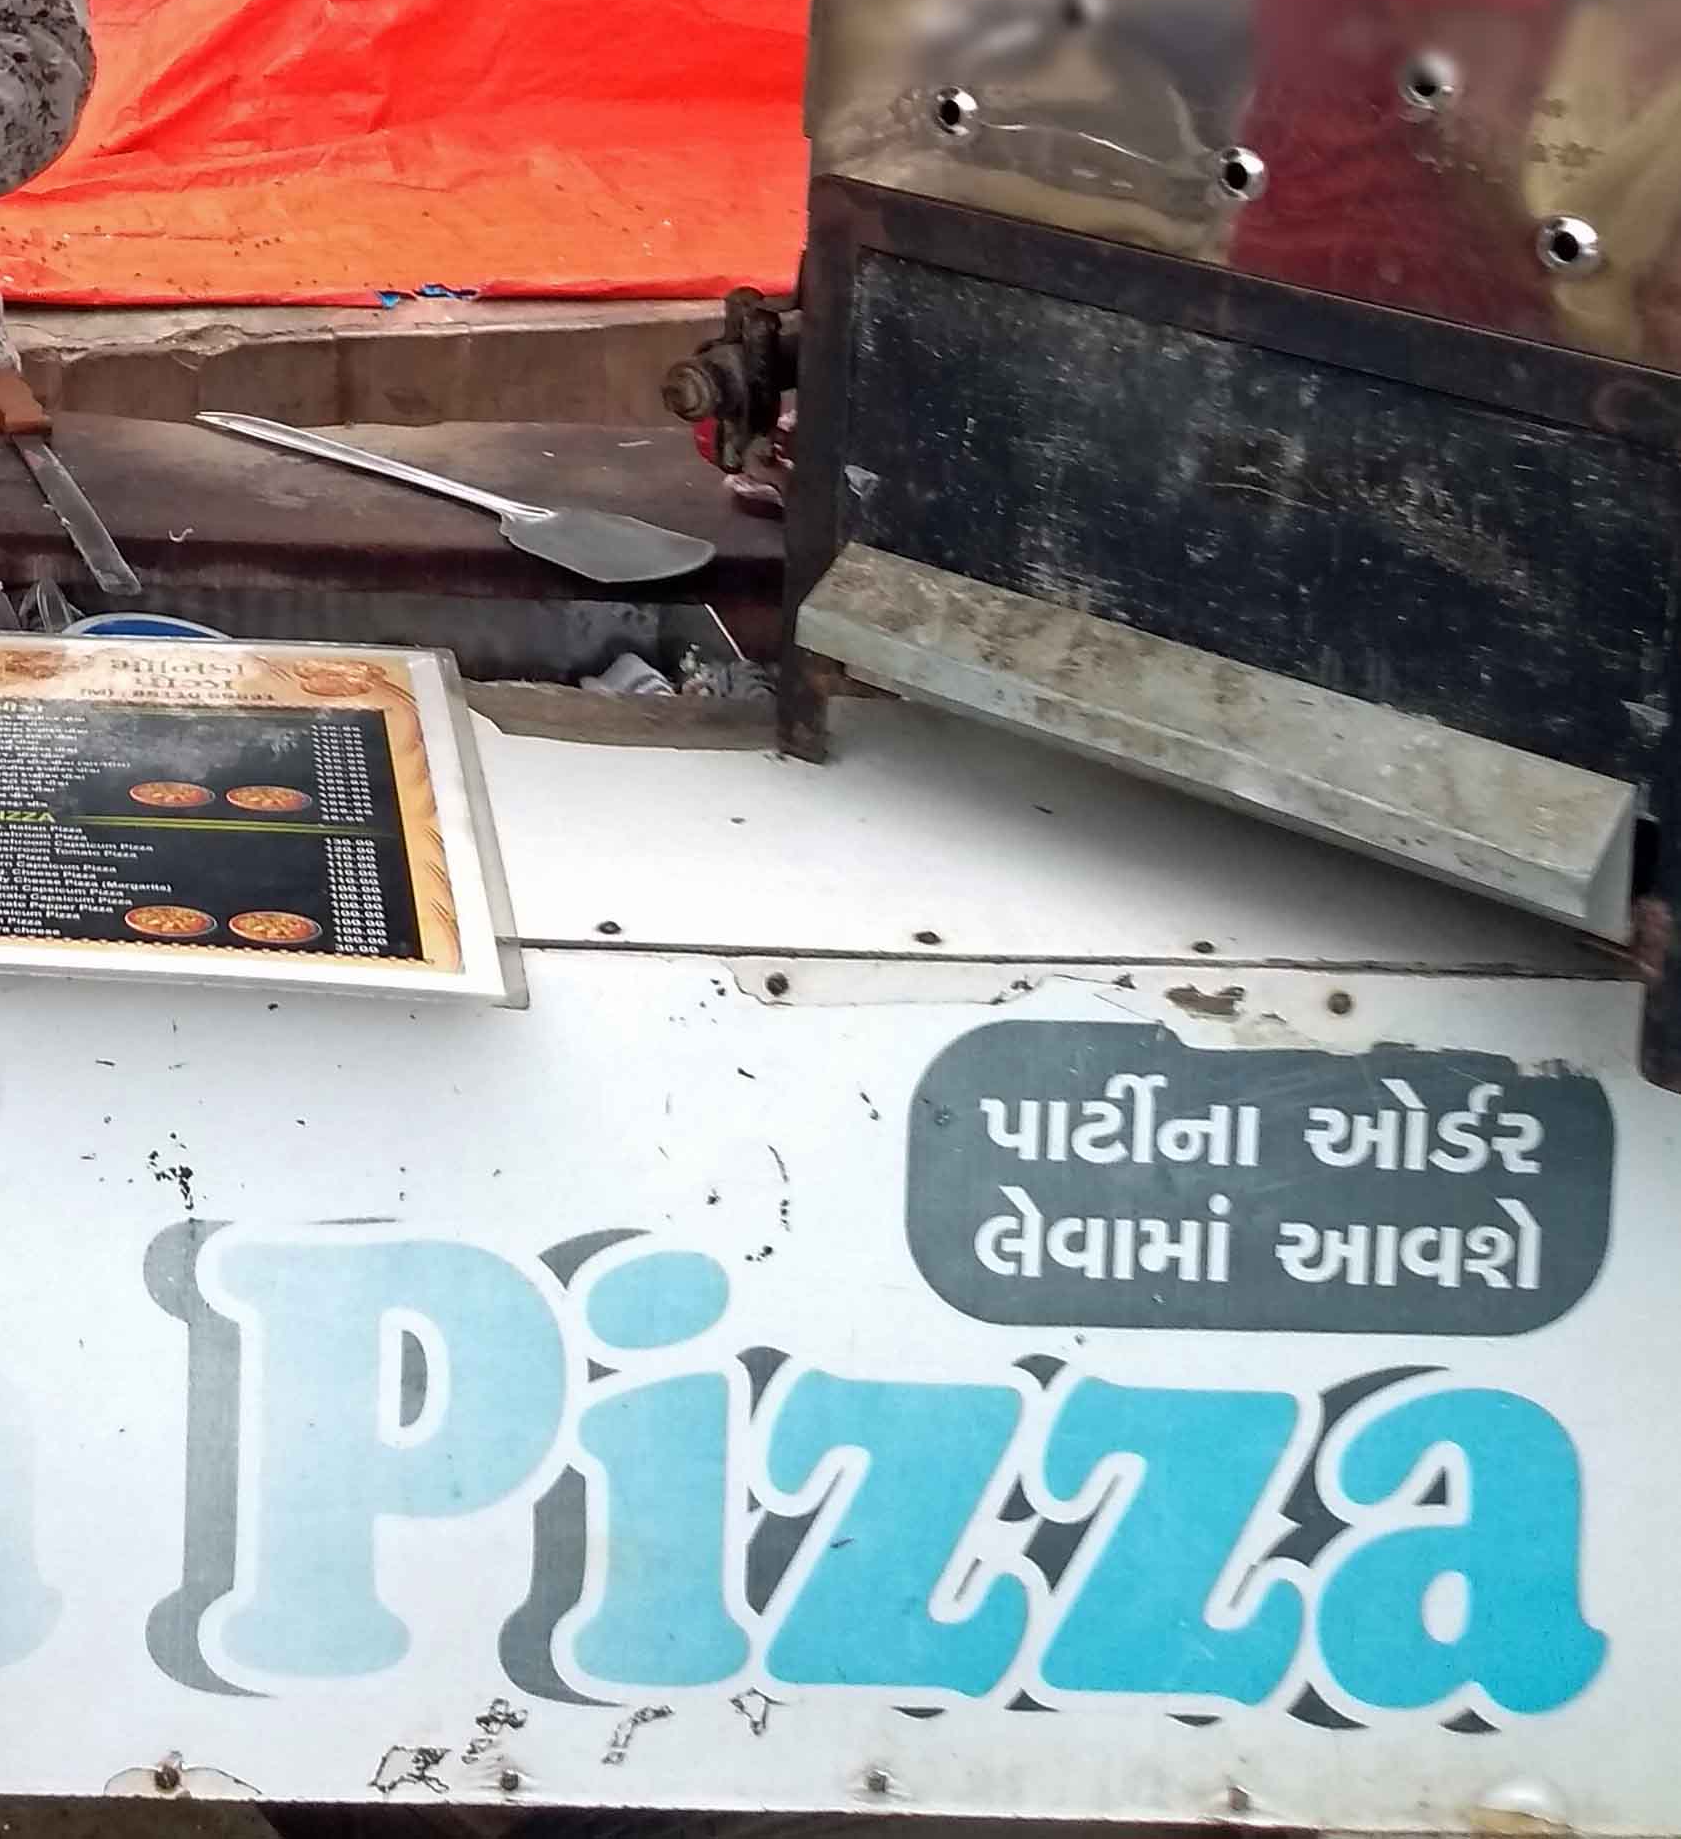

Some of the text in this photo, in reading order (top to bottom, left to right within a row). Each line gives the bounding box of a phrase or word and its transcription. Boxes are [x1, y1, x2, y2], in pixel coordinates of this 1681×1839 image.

[51, 825, 82, 833] Pizza
[55, 841, 116, 849] Capsicum
[121, 843, 153, 851] Pizza
[17, 853, 50, 861] Pizza
[55, 848, 100, 856] Tomato
[104, 850, 137, 858] Pizza
[17, 862, 79, 870] Capsicum
[83, 864, 116, 873] Pizza
[12, 869, 59, 877] Cheese
[63, 871, 96, 879] Pizza
[14, 876, 61, 884] Cheese
[65, 879, 98, 887] Pizza
[22, 885, 86, 895] Capsicum
[90, 888, 124, 896] Pizza
[31, 893, 95, 903] Capsicum
[99, 897, 133, 905] Pizza
[30, 901, 75, 911] Pepper
[80, 904, 113, 913] Pizza
[46, 911, 80, 919] Pizza
[7, 917, 42, 925] Pizza
[979, 1070, 1545, 1175] પાર્ટીના ઓર્ડર
[973, 1186, 1543, 1291] લેવામાં આવશે
[144, 1216, 1610, 1732] Pizza
